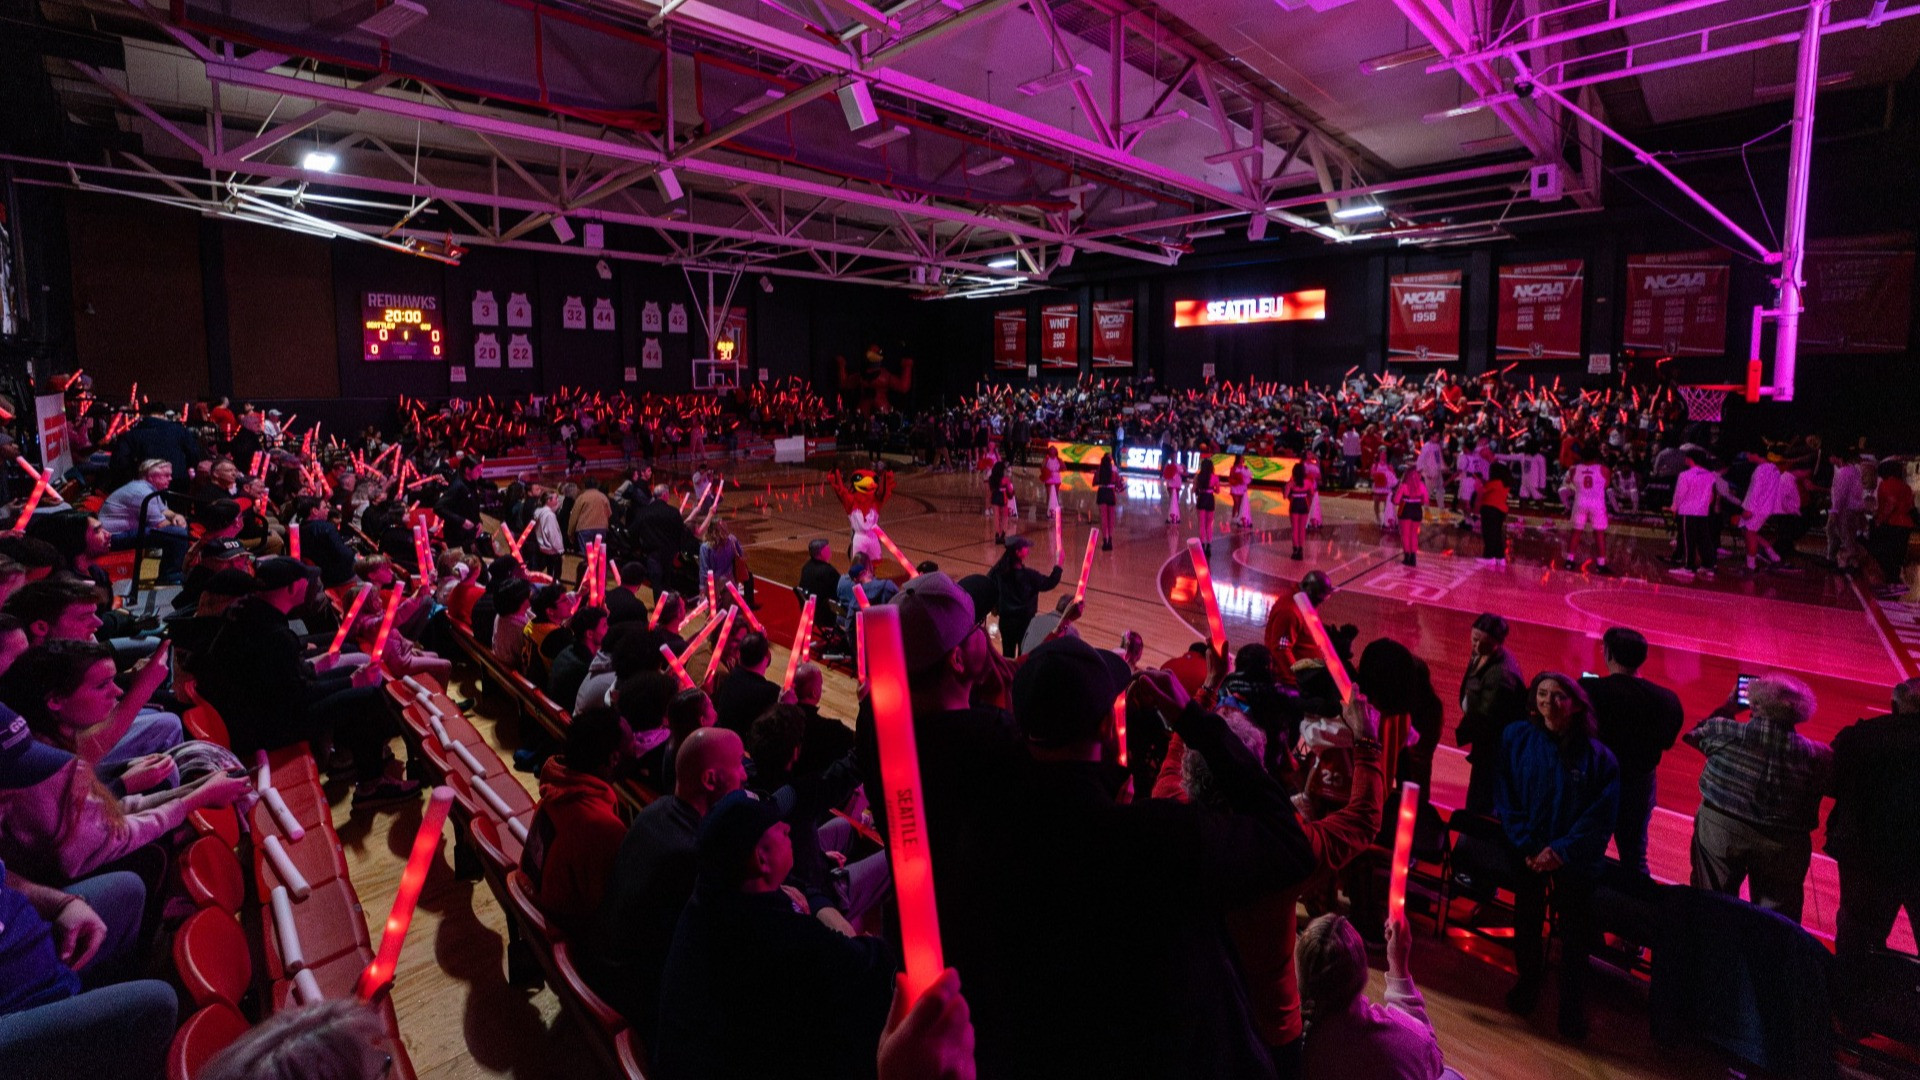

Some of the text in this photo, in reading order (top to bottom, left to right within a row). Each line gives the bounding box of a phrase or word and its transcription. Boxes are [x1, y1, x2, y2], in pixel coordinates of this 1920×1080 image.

[1643, 272, 1706, 290] NCAA
[1512, 281, 1565, 299] NCAA
[368, 293, 436, 310] REDHAWKS
[1402, 290, 1446, 306] NCAA
[385, 309, 421, 323] 20:00
[482, 305, 489, 317] 3
[516, 307, 523, 318] 4
[567, 310, 582, 321] 32
[597, 312, 611, 322] 44
[645, 314, 658, 325] 33
[672, 316, 684, 326] 42
[1099, 314, 1125, 325] NCAA
[1413, 312, 1437, 323] 1958
[1050, 318, 1070, 330] WNIT
[379, 329, 388, 341] 0
[431, 330, 440, 342] 0
[371, 344, 379, 355] 0
[433, 345, 440, 355] 0
[479, 347, 496, 359] 20
[513, 348, 528, 359] 22
[646, 351, 658, 361] 44
[897, 788, 918, 848] SEATTLE
